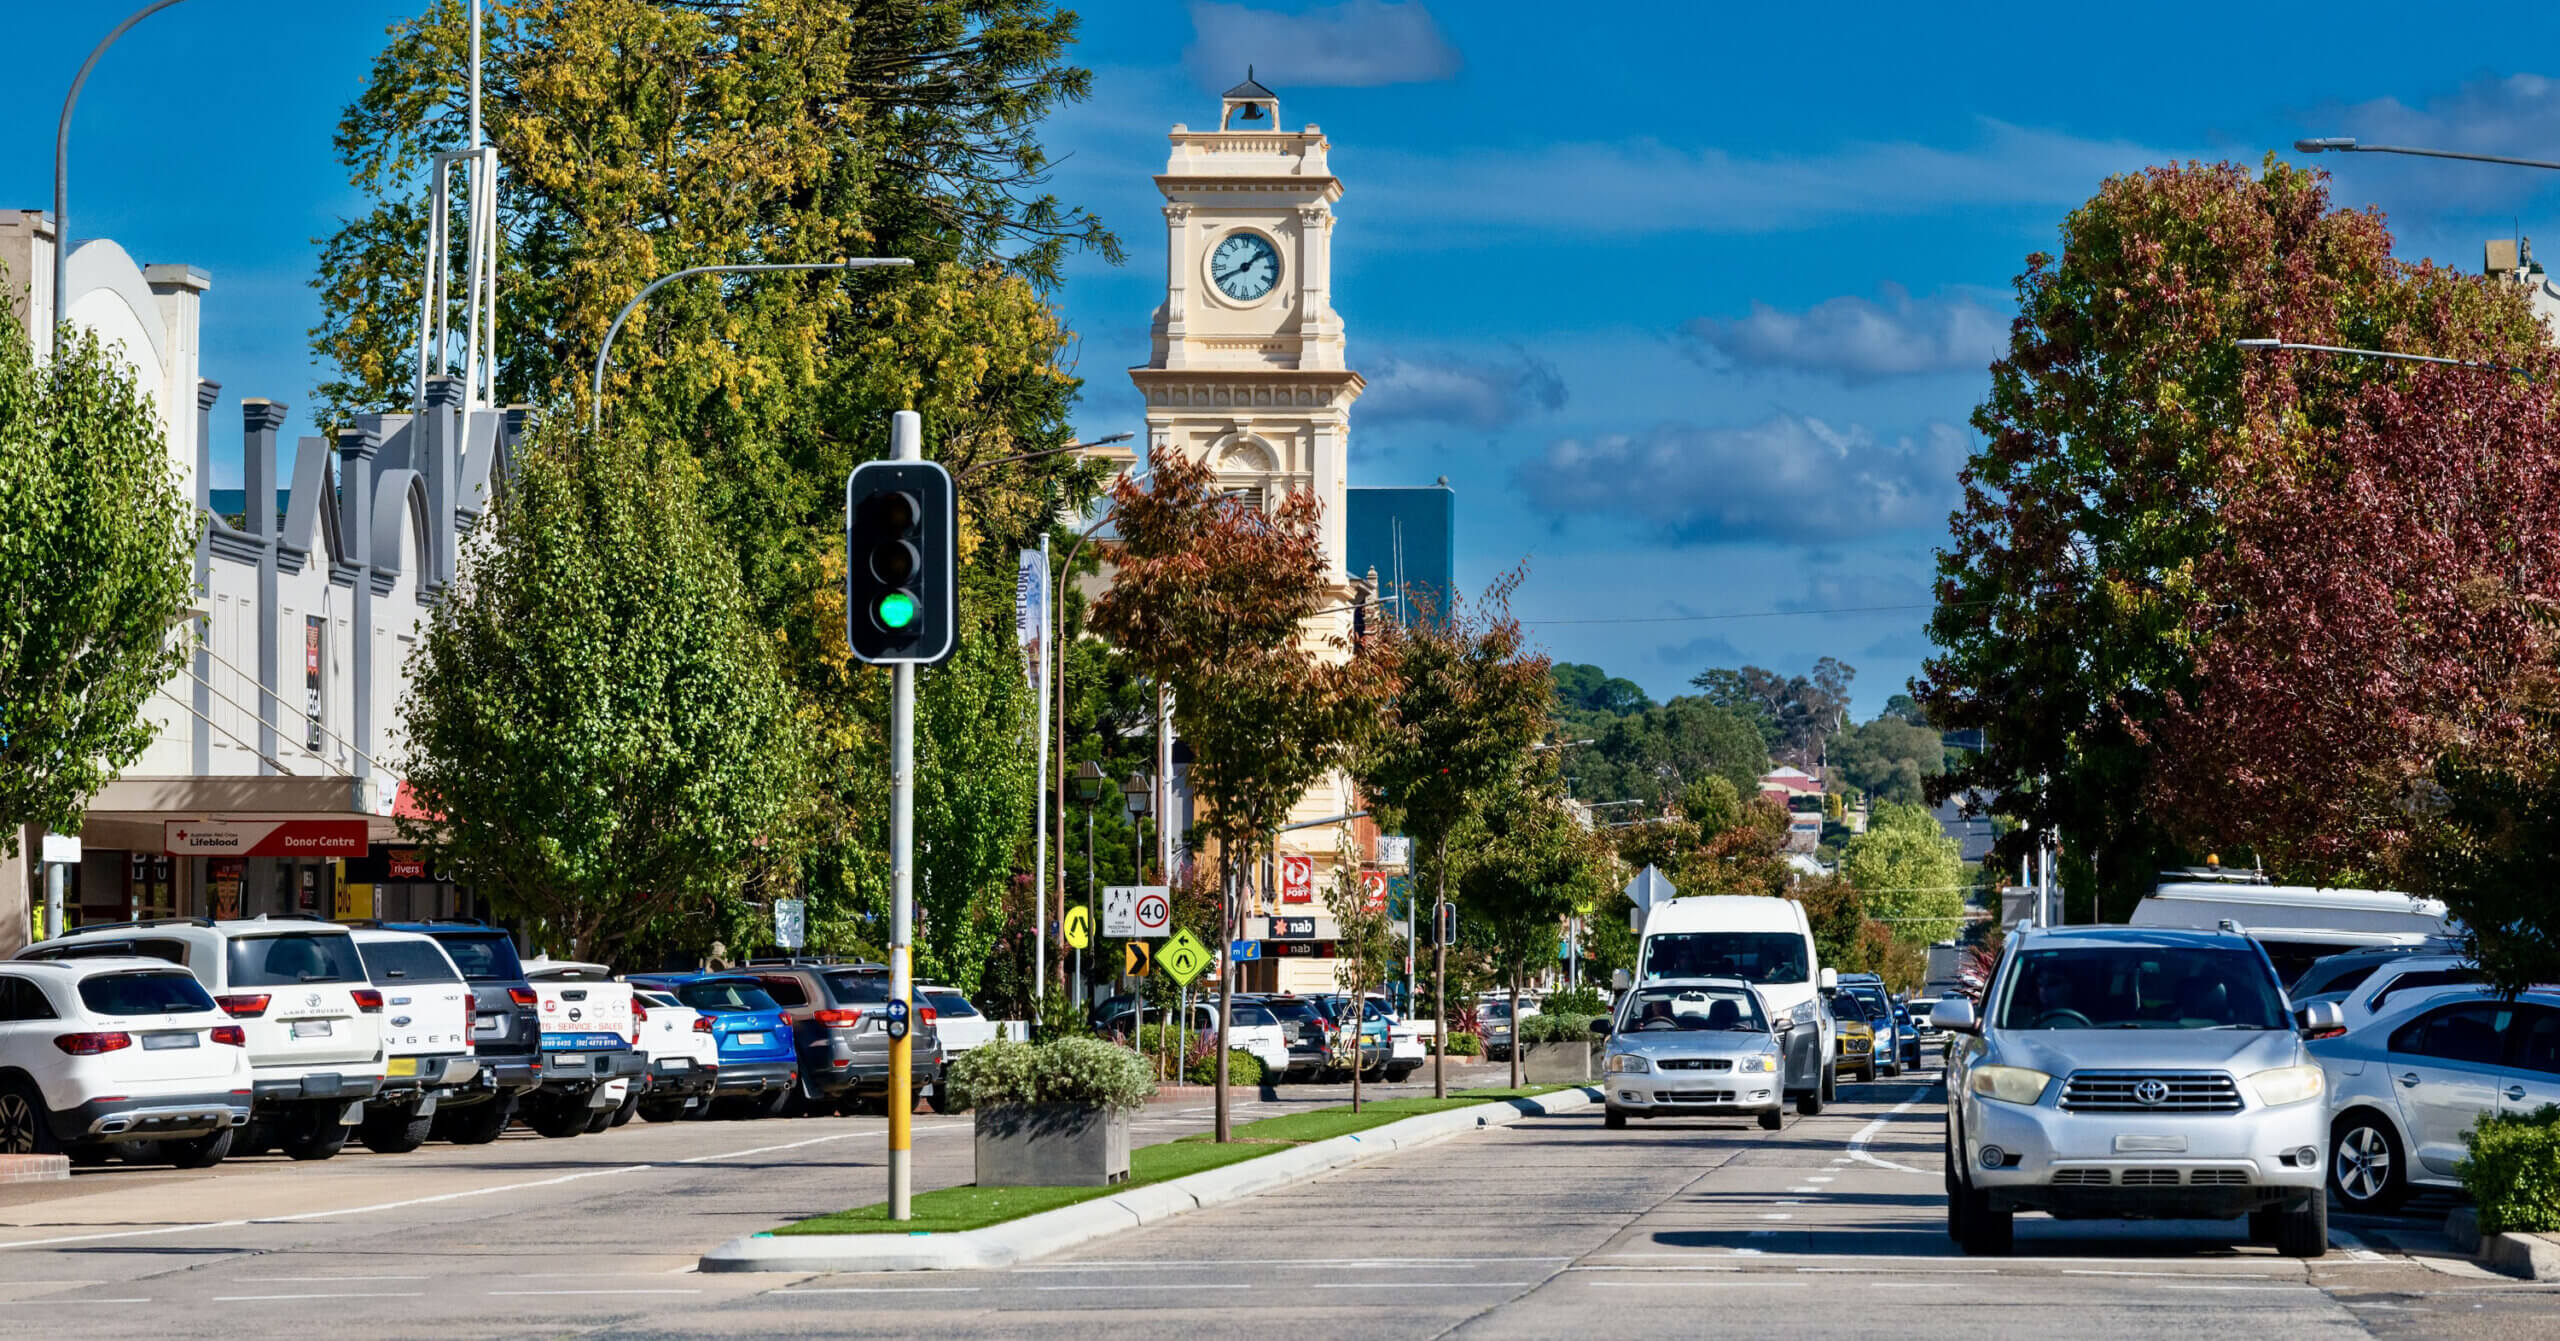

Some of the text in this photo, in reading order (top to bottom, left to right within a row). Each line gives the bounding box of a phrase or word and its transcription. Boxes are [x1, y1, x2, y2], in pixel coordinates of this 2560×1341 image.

[190, 838, 238, 846] Lifeblood
[285, 836, 355, 846] Donor Centre
[394, 864, 420, 874] rivers
[1141, 904, 1165, 919] 40
[1290, 920, 1312, 932] nab
[1290, 944, 1310, 952] nab
[385, 1033, 461, 1045] NGER
